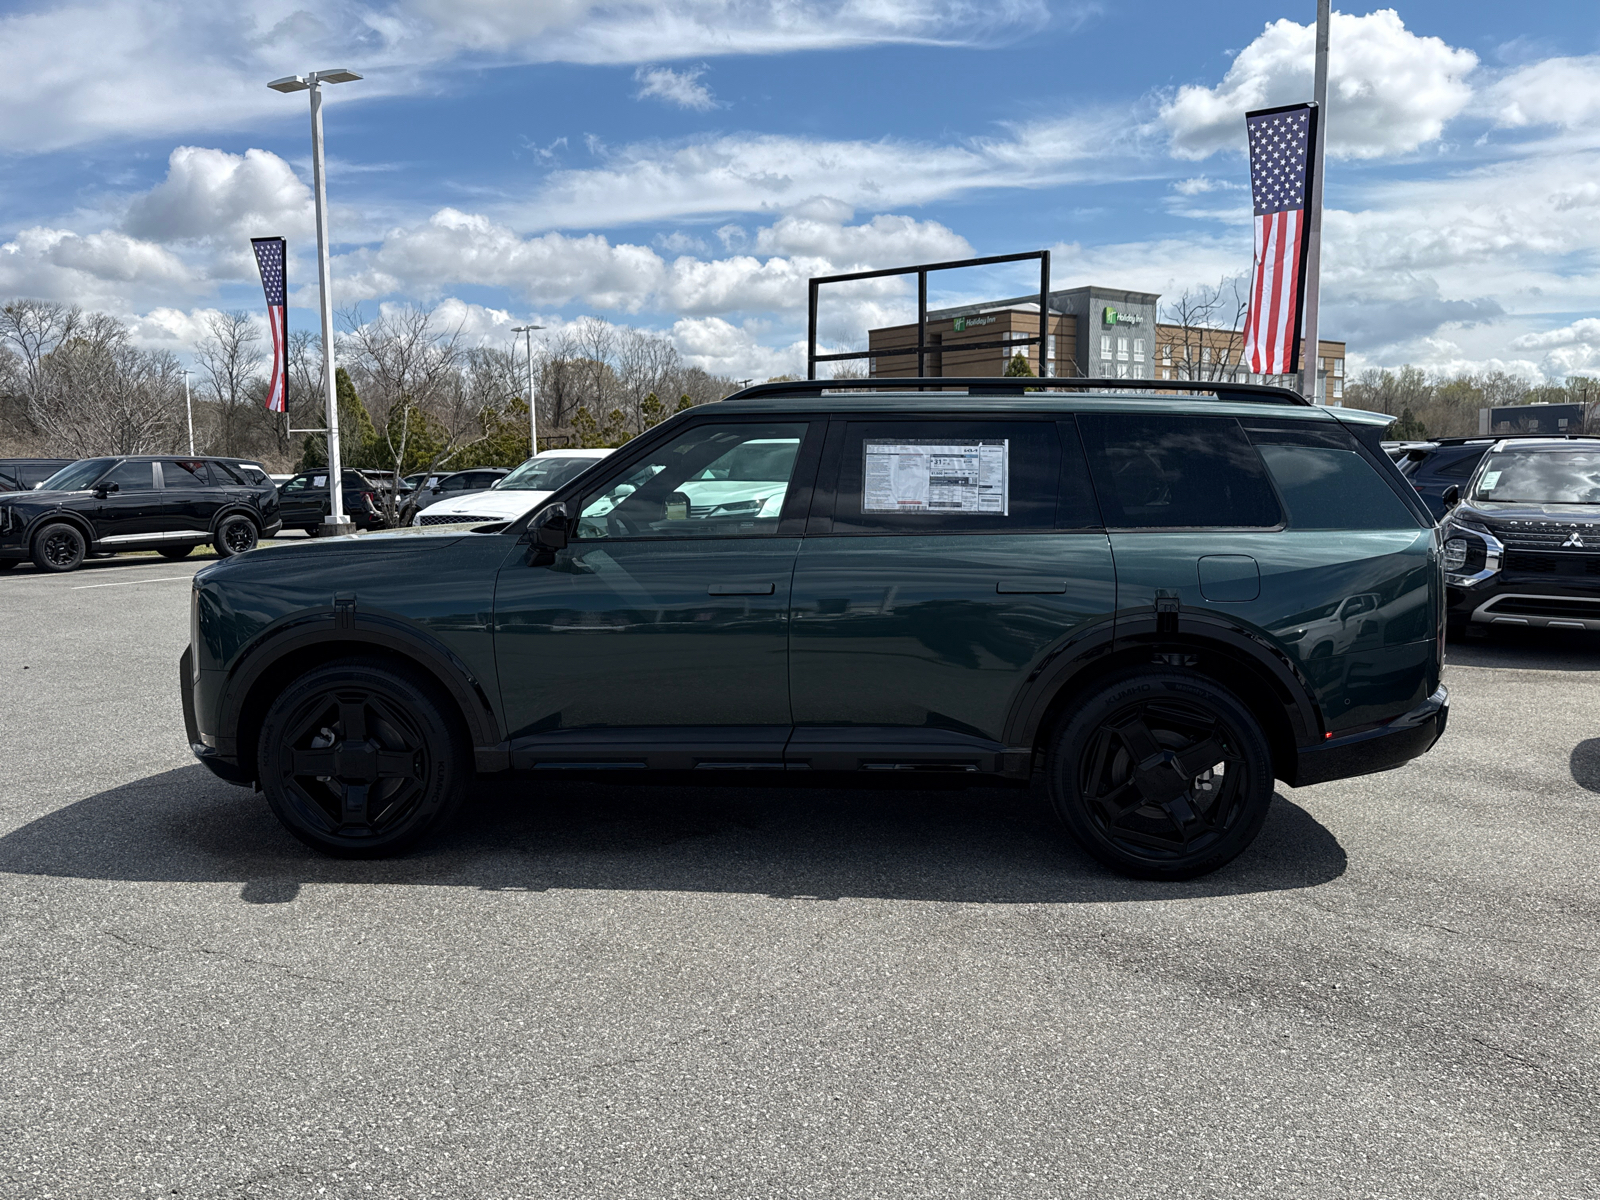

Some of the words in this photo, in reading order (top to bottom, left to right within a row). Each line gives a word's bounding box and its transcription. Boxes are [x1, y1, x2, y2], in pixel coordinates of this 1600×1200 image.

[966, 317, 986, 327] Holiday
[986, 315, 996, 324] Inn
[1116, 312, 1135, 324] Holiday
[1135, 314, 1143, 323] Inn
[1105, 684, 1151, 706] KUMHO
[431, 760, 445, 803] KUMHO
